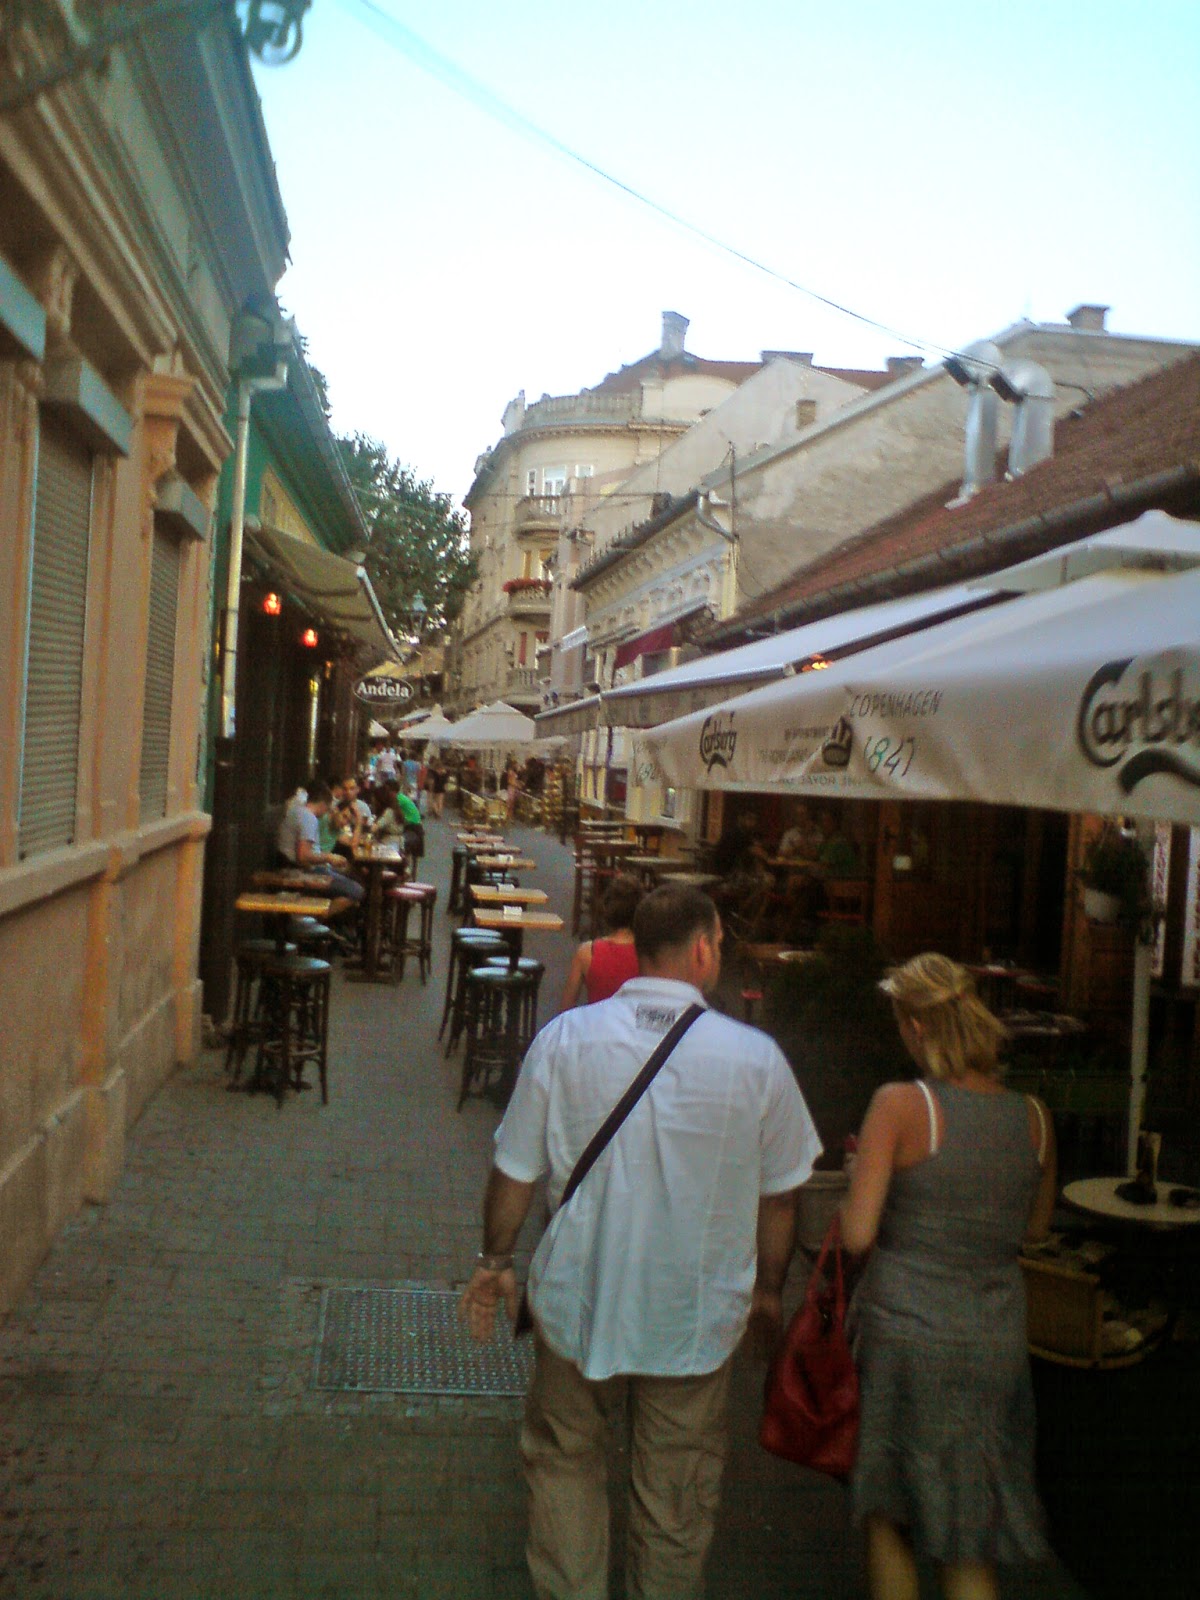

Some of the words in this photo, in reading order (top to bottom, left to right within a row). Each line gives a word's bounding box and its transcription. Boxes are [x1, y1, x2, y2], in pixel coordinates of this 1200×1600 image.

[849, 689, 944, 718] COPENHAGEN
[699, 711, 737, 765] Carlsberg
[863, 735, 915, 777] 1847
